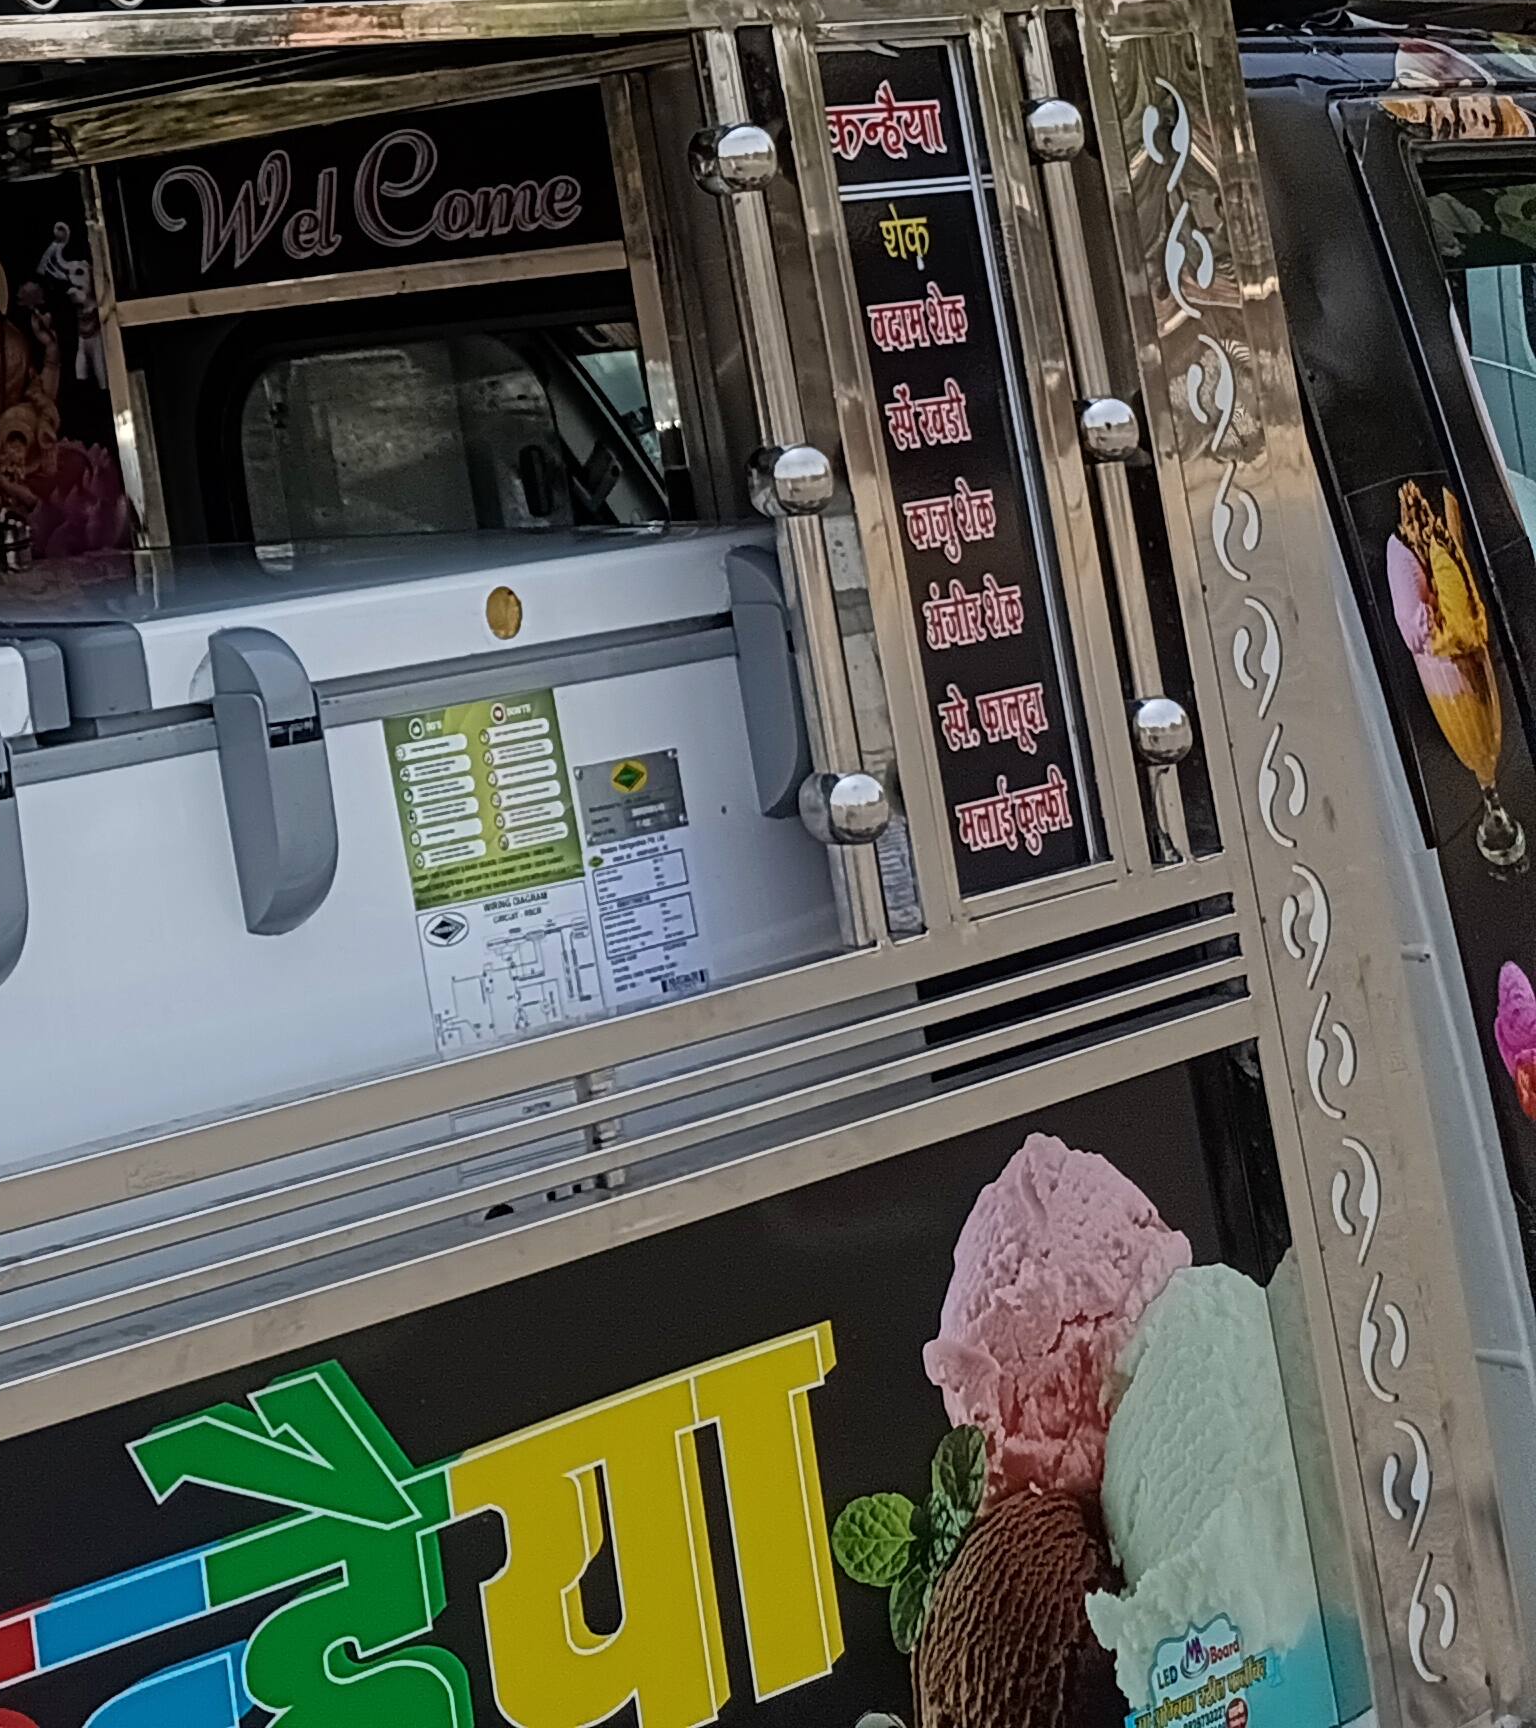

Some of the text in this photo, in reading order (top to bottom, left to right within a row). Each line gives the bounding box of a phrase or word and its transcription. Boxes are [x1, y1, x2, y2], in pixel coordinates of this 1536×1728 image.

[825, 80, 947, 161] कन्हैया
[353, 128, 582, 248] Come
[880, 203, 929, 262] शेक
[903, 476, 997, 564] काजु शेक
[982, 573, 1024, 640] शेक
[956, 775, 1018, 852] मलाई
